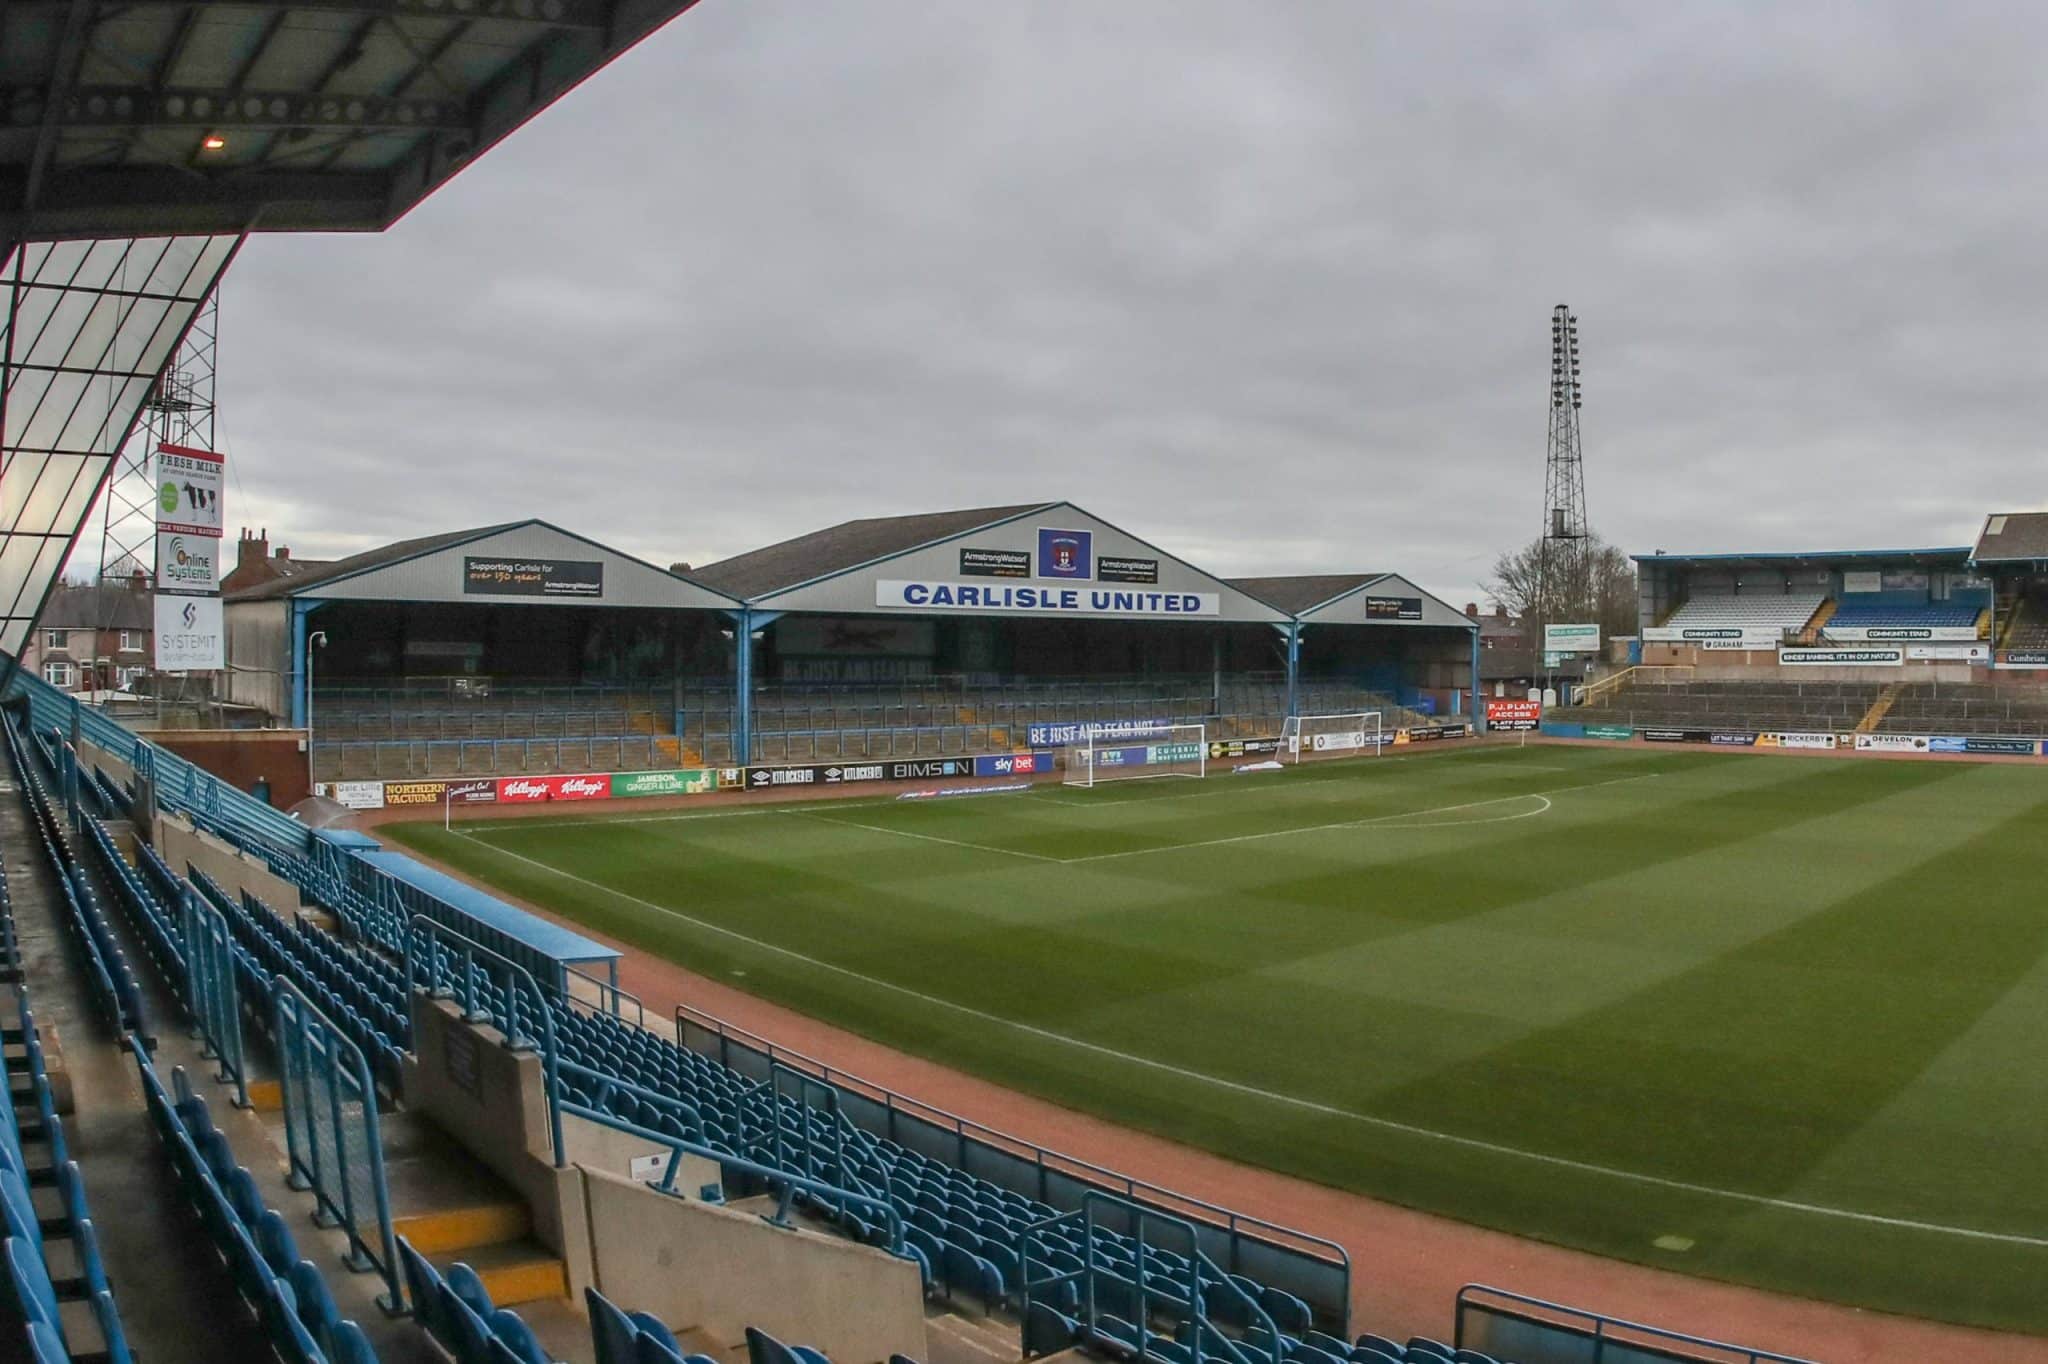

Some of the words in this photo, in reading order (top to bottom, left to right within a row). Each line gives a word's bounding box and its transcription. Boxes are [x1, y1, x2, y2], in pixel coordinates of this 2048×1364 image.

[159, 454, 193, 470] FRESH
[196, 460, 222, 474] MILK
[177, 549, 209, 568] Online
[167, 563, 211, 581] Systems
[469, 562, 513, 573] Supporting
[515, 563, 540, 573] Carlisle
[542, 564, 553, 573] for
[903, 583, 1078, 609] CARLISLE
[1091, 591, 1201, 612] UNITED
[162, 634, 217, 649] SYSTEMIT
[1712, 641, 1743, 649] GRAHAM
[2008, 654, 2046, 662] Cumbrian
[1507, 703, 1538, 711] PLANT
[1031, 727, 1047, 744] BE
[1050, 726, 1076, 743] JUST
[1078, 722, 1101, 740] AND
[1104, 722, 1131, 738] FEAR
[1134, 720, 1154, 737] NOT
[1787, 735, 1826, 743] RICKERBY
[1872, 735, 1913, 743] DEVELON
[893, 760, 970, 778] BIMSON
[994, 758, 1013, 773] sky
[1015, 757, 1033, 769] bet
[386, 783, 446, 794] NORTHERN
[504, 781, 549, 798] Kellogg's
[561, 779, 605, 796] Kellogg's
[626, 782, 658, 792] GINGER
[665, 780, 684, 789] LIME
[386, 793, 437, 804] VACUUMS
